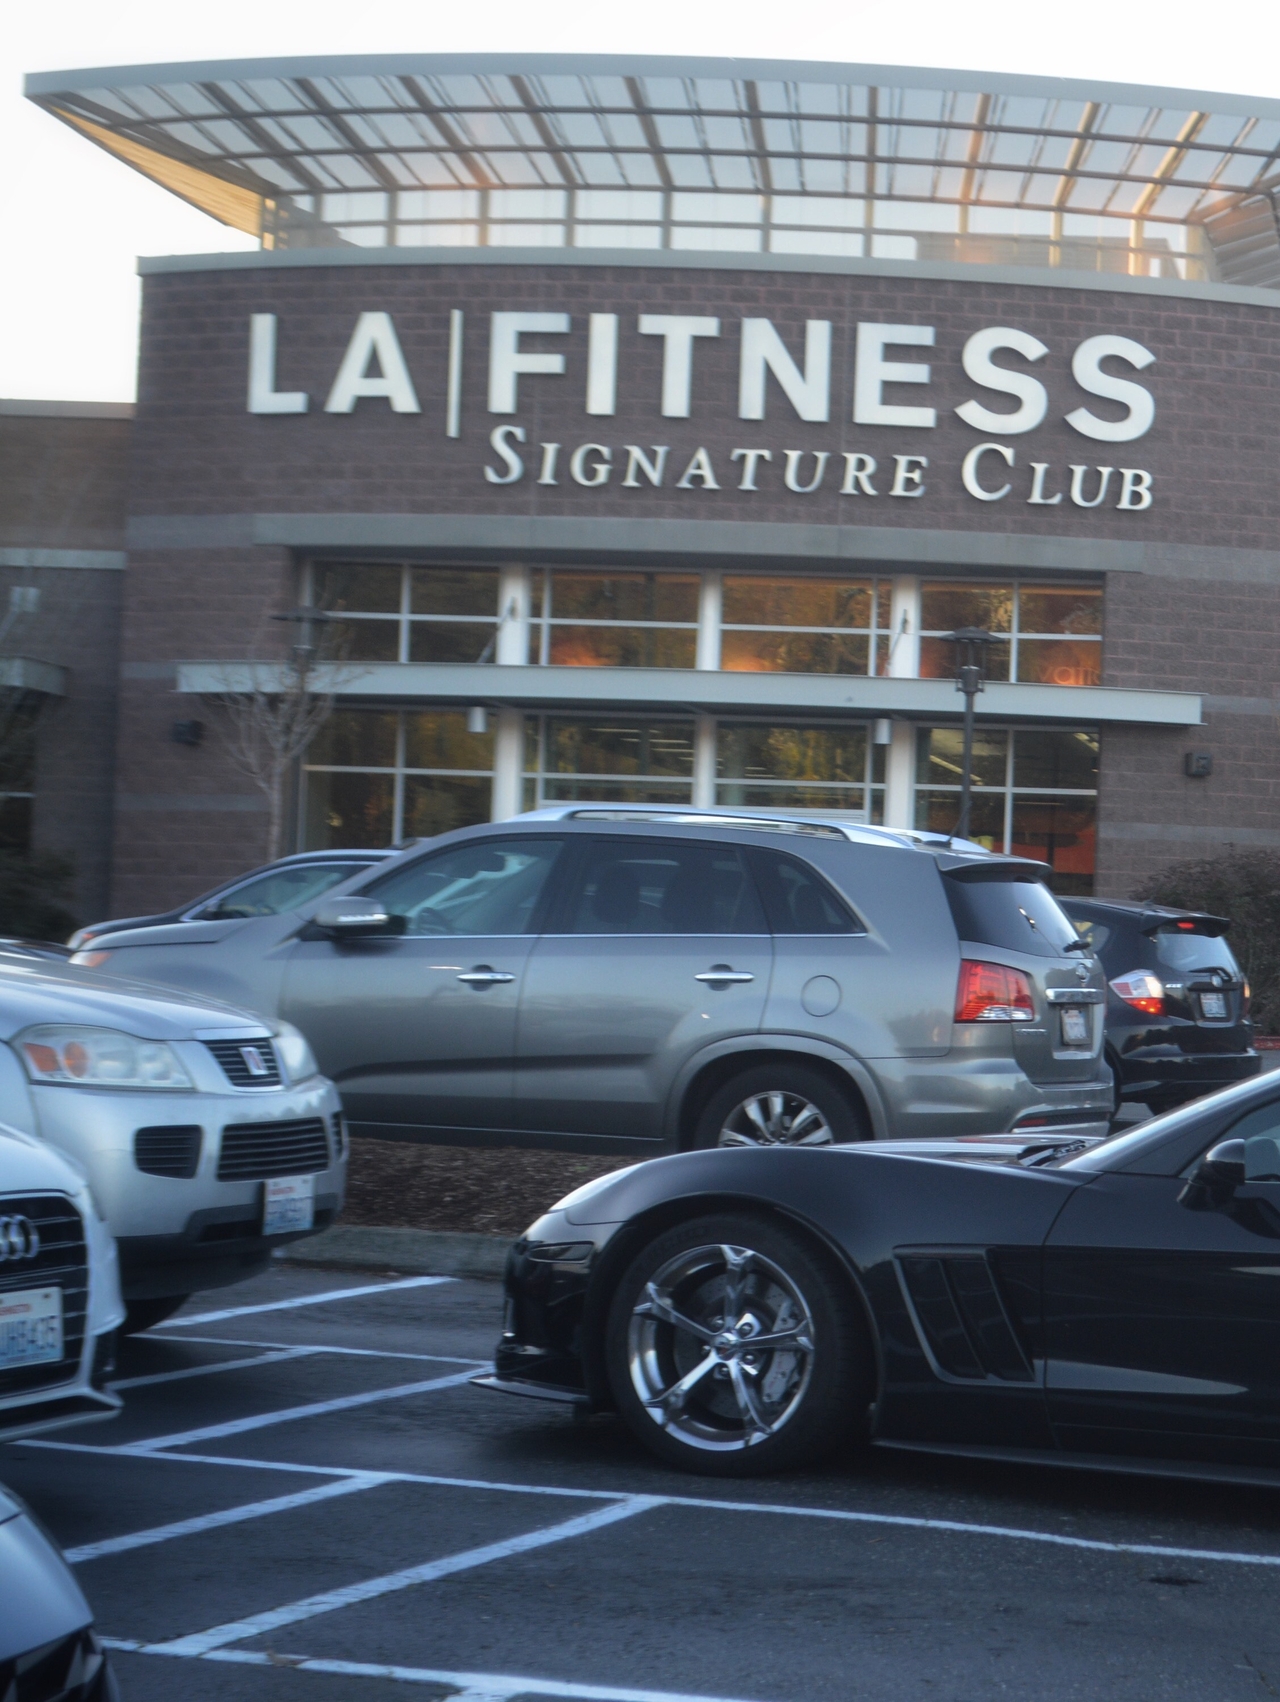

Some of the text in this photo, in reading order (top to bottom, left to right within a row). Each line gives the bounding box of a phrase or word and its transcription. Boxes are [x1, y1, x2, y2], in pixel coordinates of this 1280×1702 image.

[247, 311, 1157, 443] LA FITNESS
[484, 424, 1154, 511] SIGNATURE CLUB
